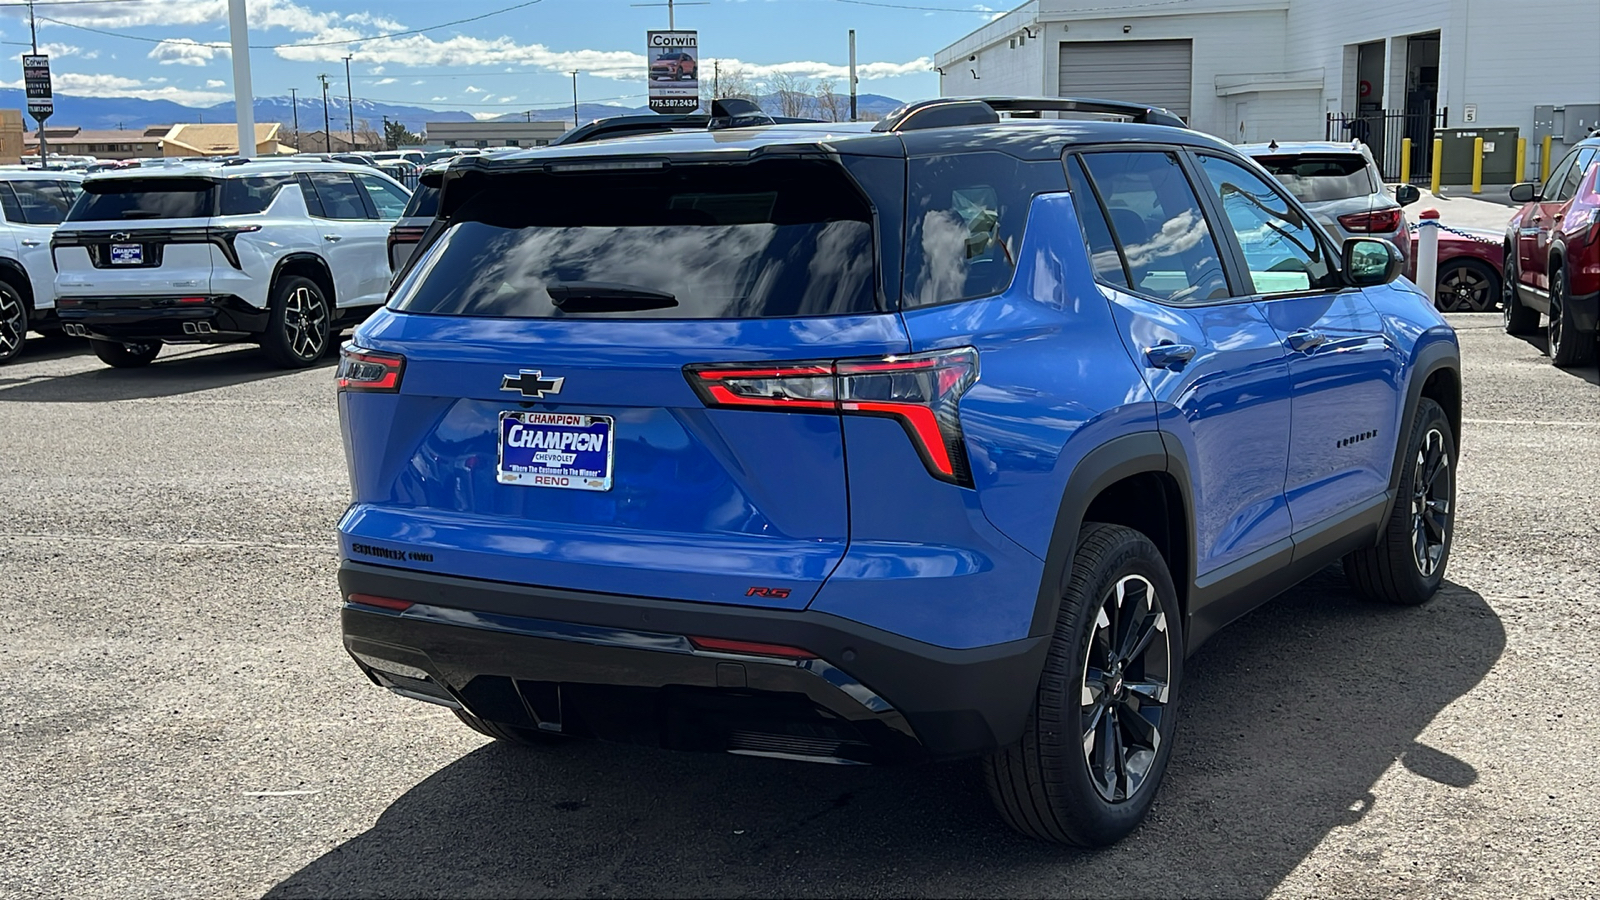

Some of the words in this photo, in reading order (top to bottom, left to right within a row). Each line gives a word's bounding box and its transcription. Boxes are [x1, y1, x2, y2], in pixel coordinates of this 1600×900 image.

[653, 35, 696, 46] Corwin
[25, 58, 48, 66] Corwin
[25, 70, 49, 78] GMC
[1467, 113, 1473, 121] 5
[528, 413, 581, 425] CHAMPION
[507, 424, 604, 452] CHAMPION
[535, 453, 573, 463] CHEVROLET
[528, 465, 538, 473] The
[569, 467, 578, 476] The
[534, 475, 570, 486] RENO
[744, 586, 792, 599] RS
